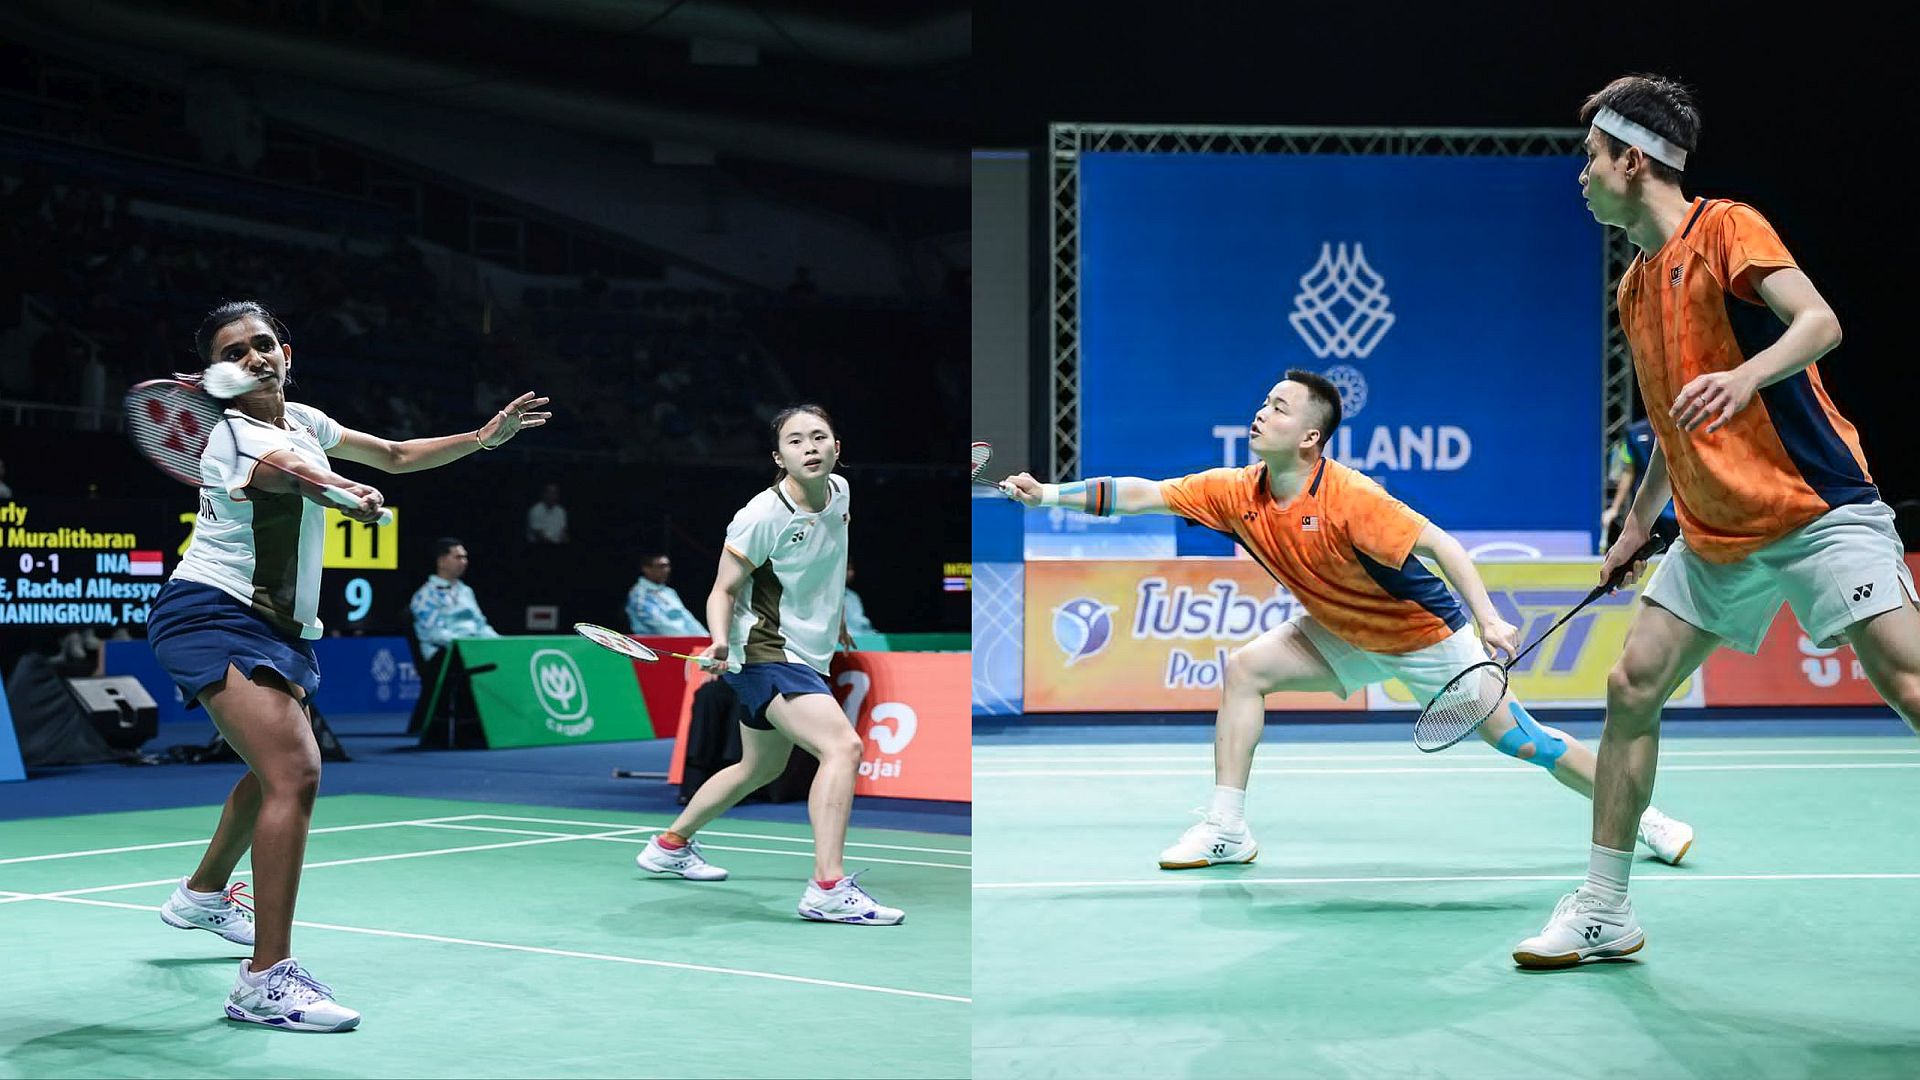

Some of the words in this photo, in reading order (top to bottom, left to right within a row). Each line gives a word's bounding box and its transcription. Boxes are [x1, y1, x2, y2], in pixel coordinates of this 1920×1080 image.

[1212, 425, 1472, 471] TLAND
[8, 527, 137, 549] Muralitharan
[336, 519, 379, 559] 11
[96, 552, 130, 574] INA
[16, 577, 82, 599] Rachel
[344, 577, 373, 622] 9
[858, 758, 902, 781] ojai
